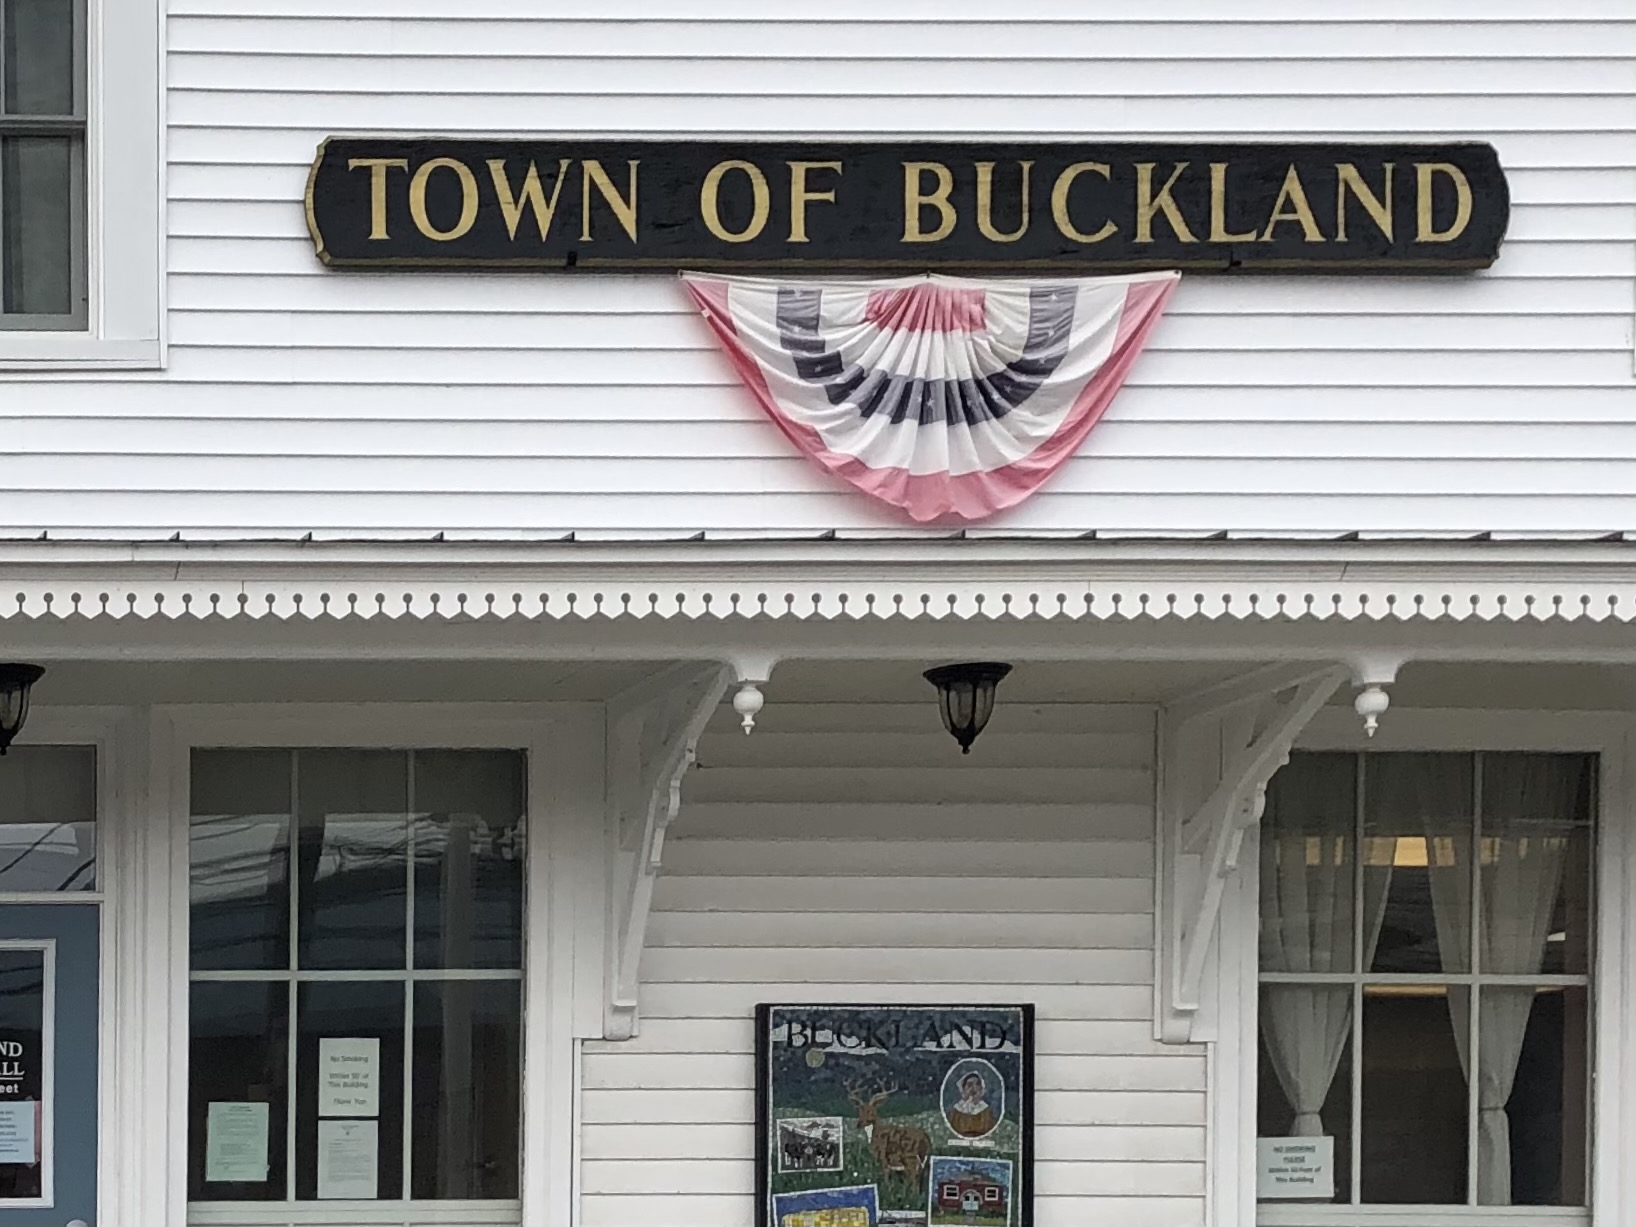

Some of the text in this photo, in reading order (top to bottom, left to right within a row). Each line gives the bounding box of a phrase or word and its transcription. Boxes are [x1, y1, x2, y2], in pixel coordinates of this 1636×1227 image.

[347, 156, 1474, 244] TOWN OF BUCKLAND
